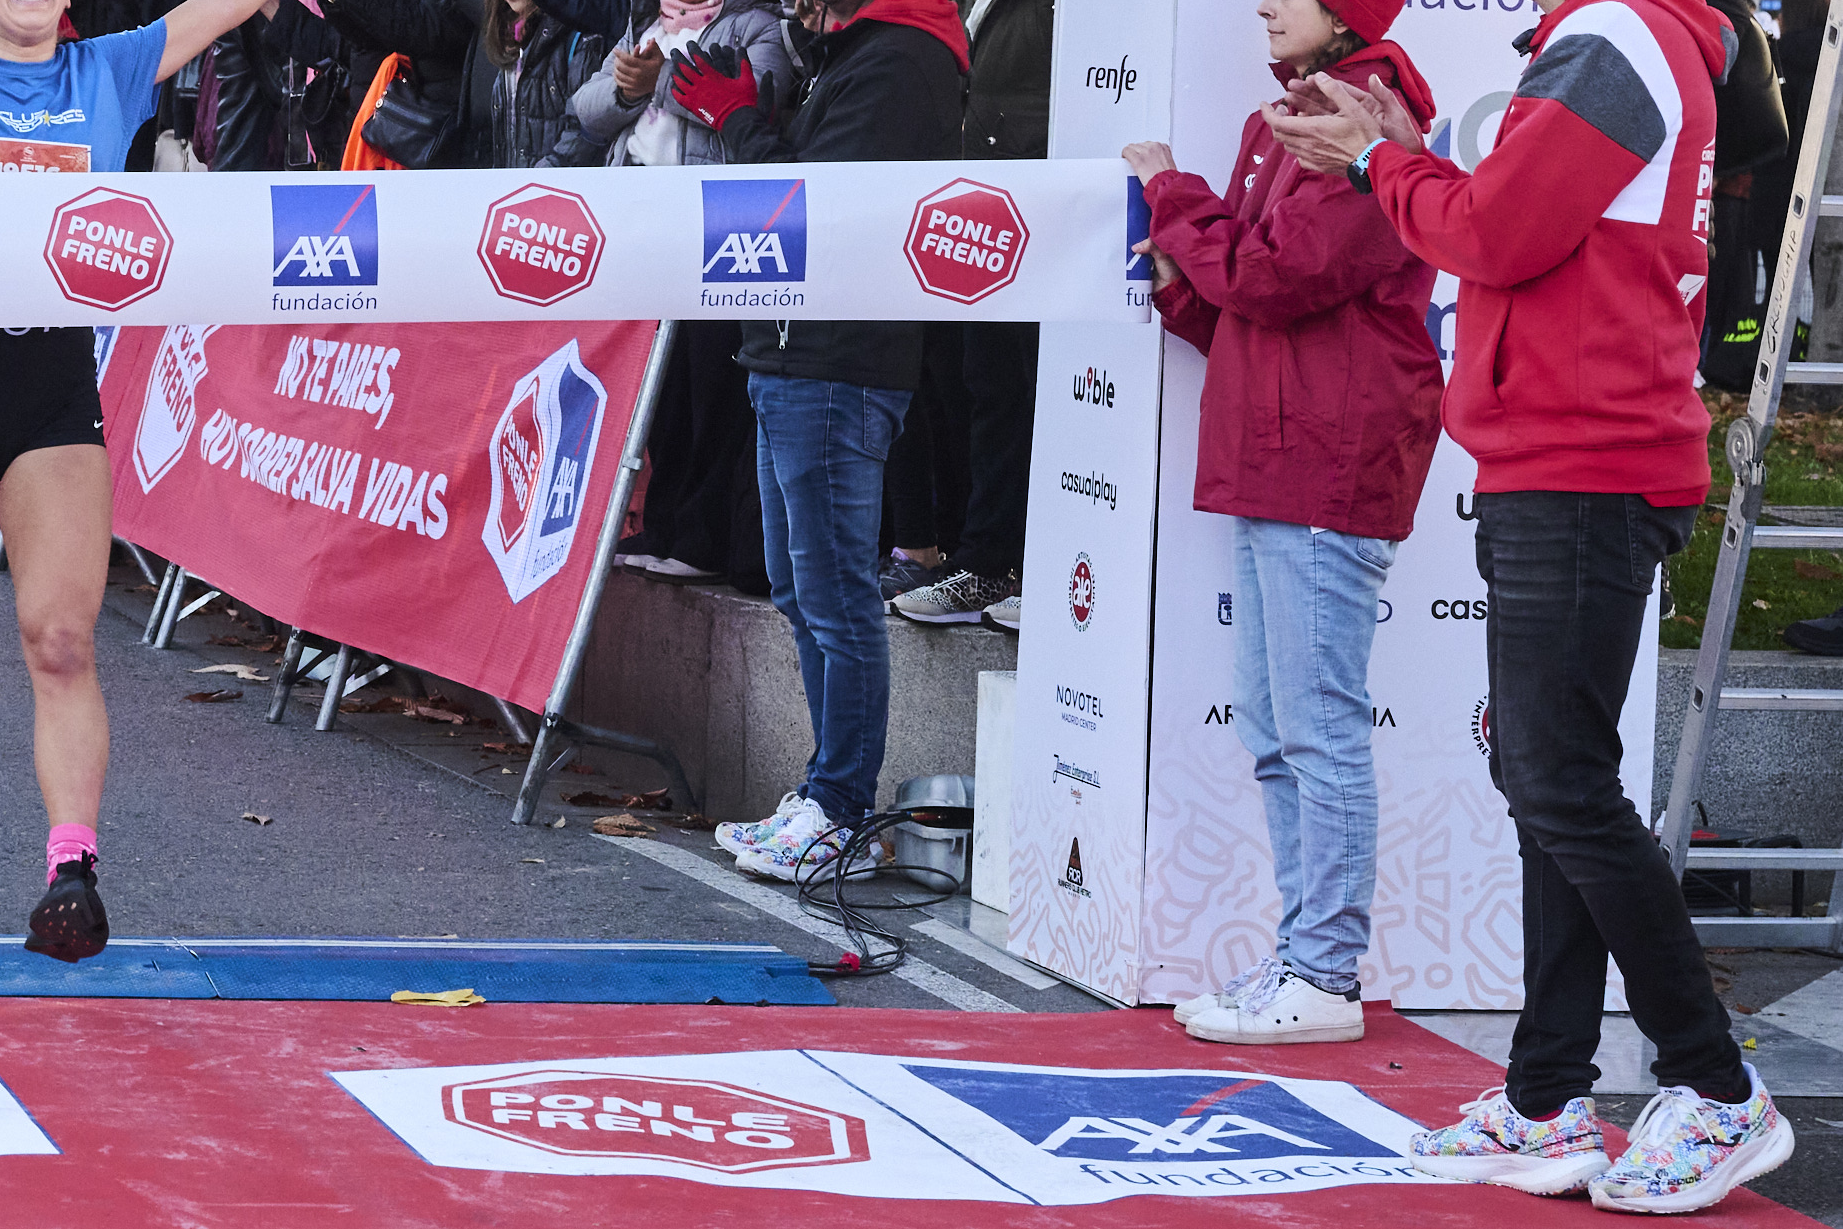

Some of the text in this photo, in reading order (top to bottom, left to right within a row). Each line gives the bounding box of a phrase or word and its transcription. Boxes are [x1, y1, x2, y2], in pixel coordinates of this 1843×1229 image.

[1086, 53, 1138, 105] renfe
[67, 214, 157, 259] PONLE
[500, 212, 588, 256] PONLE
[919, 232, 1007, 273] FRENO
[927, 209, 1014, 253] PONLE
[60, 239, 150, 281] FRENO
[271, 235, 361, 279] AXA
[493, 235, 583, 277] FRENO
[701, 232, 789, 274] AXA
[270, 291, 378, 313] fundación
[700, 286, 806, 308] fundación
[158, 343, 193, 433] FRENO
[273, 335, 401, 430] NO TE PARES,
[1073, 366, 1115, 409] wible
[503, 413, 538, 482] PONLE
[291, 441, 362, 515] SALVA
[358, 457, 449, 540] VIDAS
[502, 444, 528, 512] FRENO
[545, 455, 578, 520] AXA
[1061, 470, 1117, 511] casualplay
[1056, 684, 1104, 718] NOVOTEL
[490, 1091, 789, 1132] PONLE
[491, 1108, 795, 1150] FRENO
[1039, 1114, 1331, 1155] AXA
